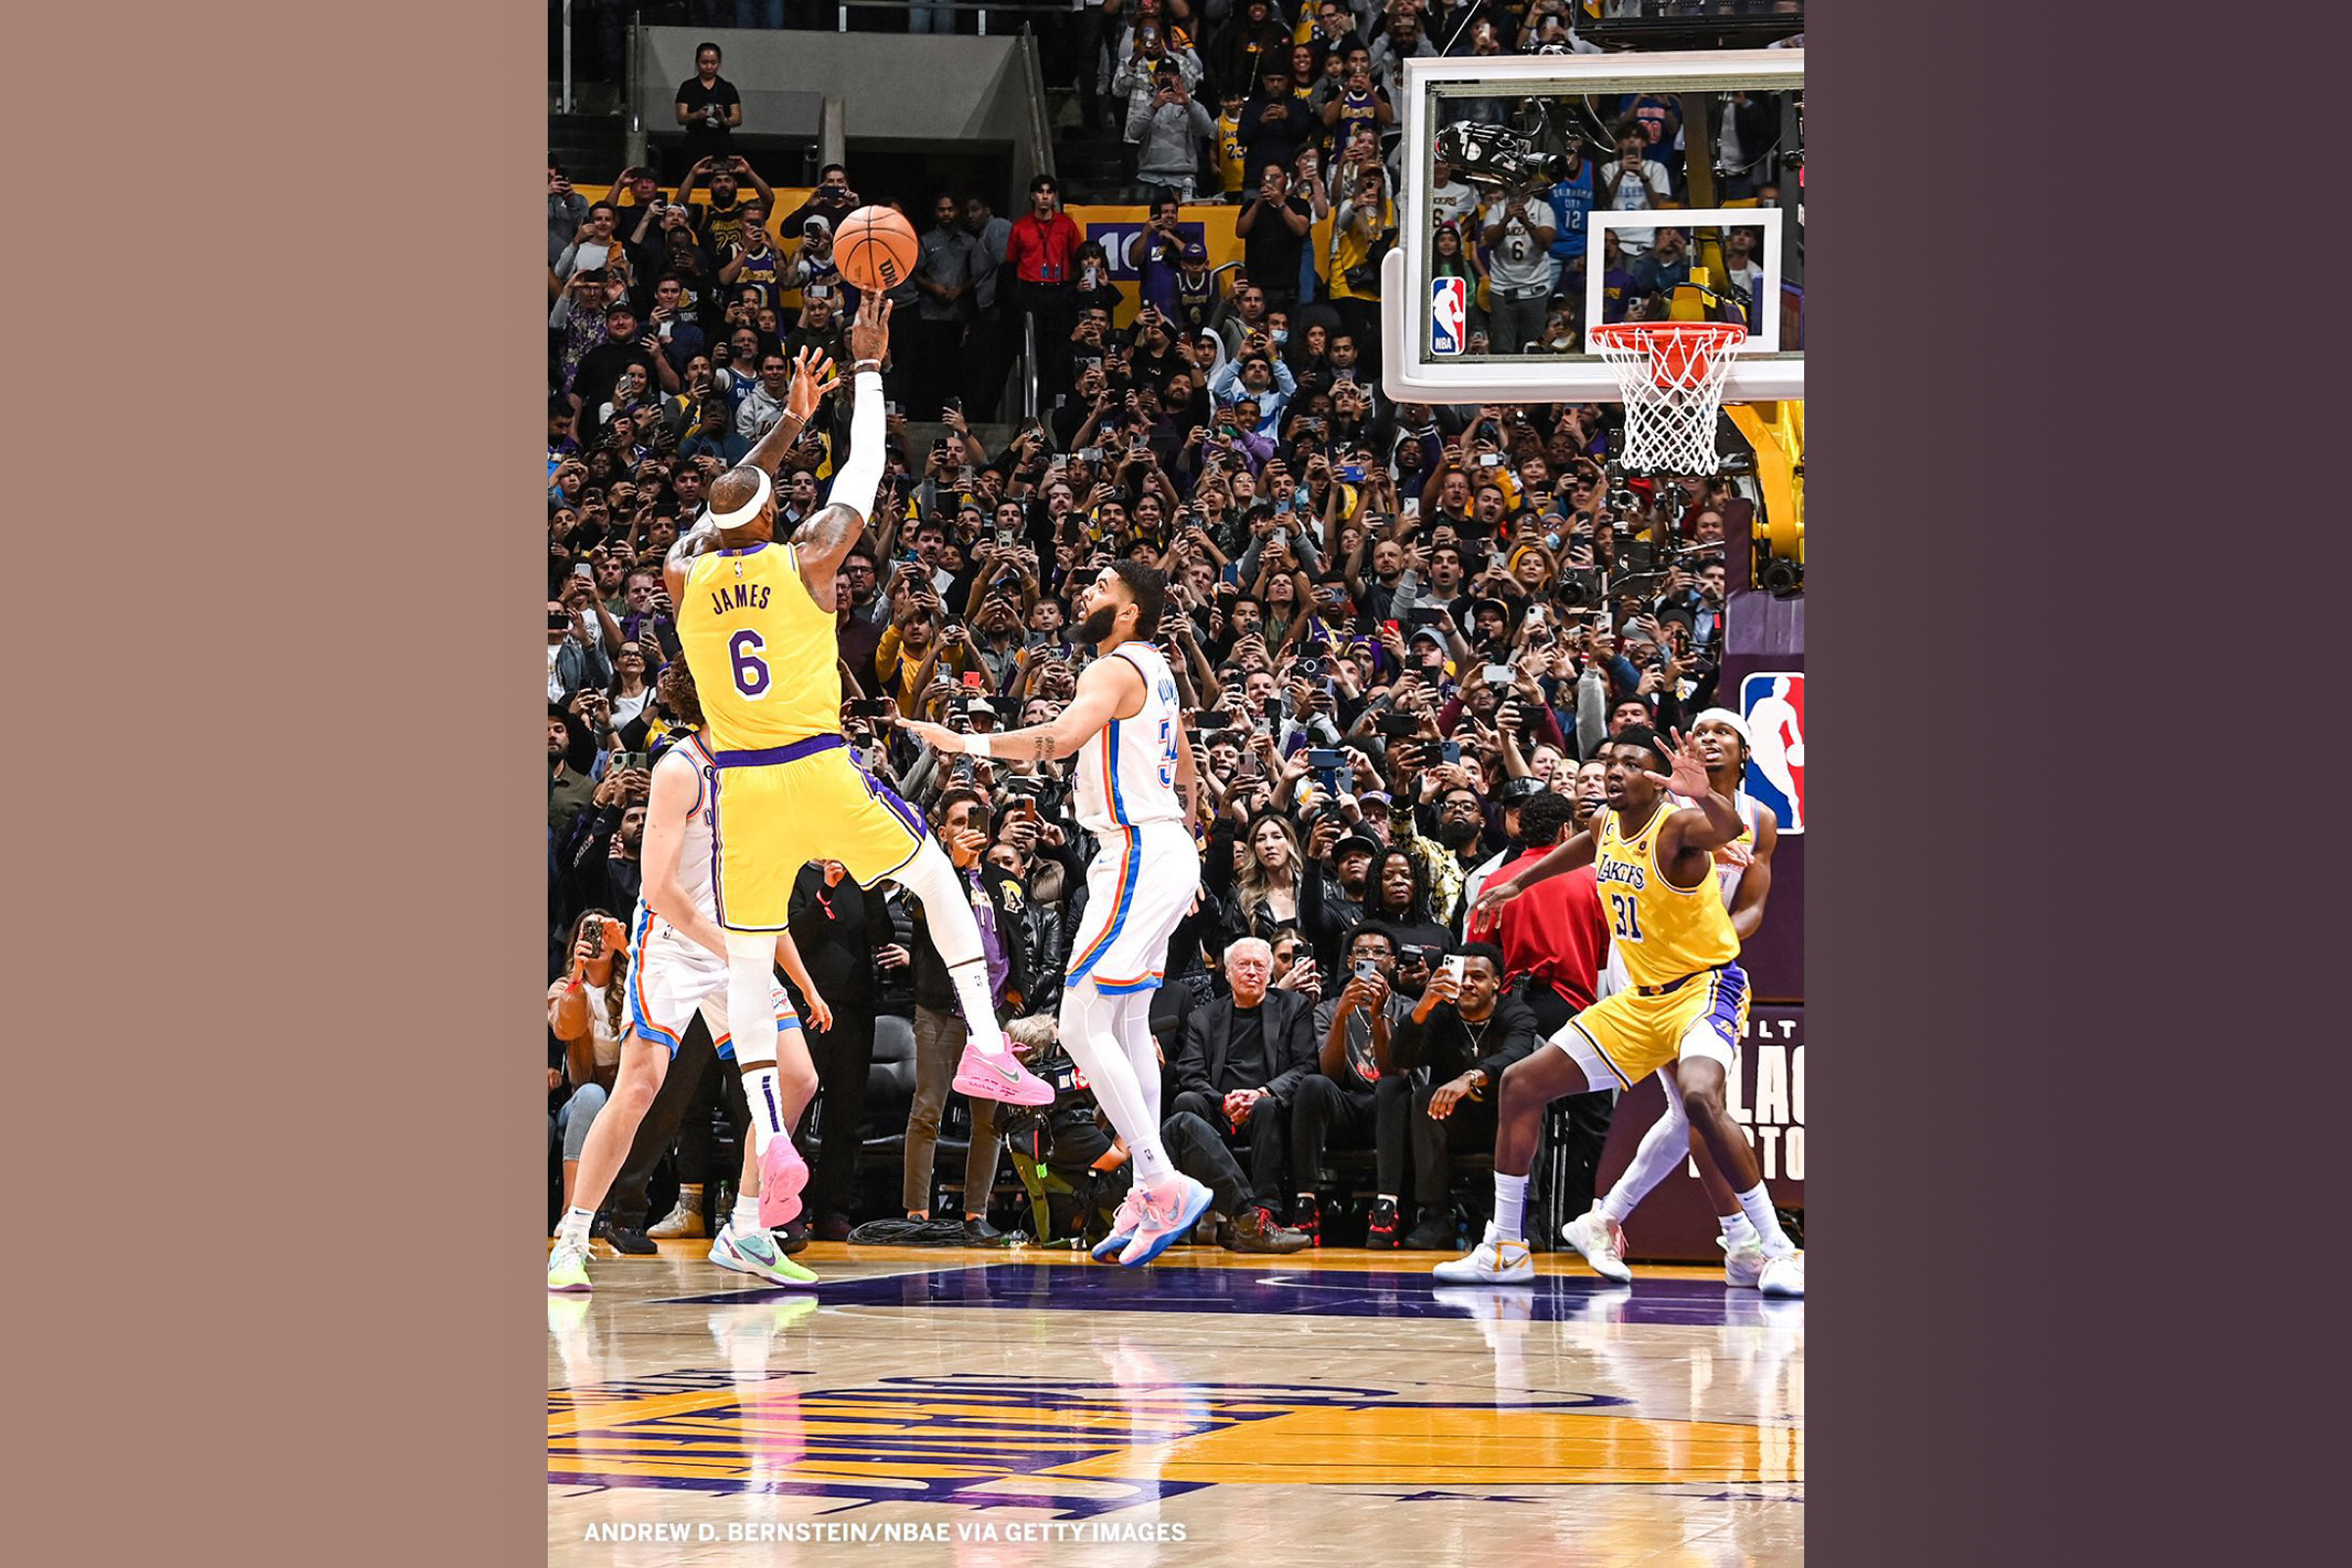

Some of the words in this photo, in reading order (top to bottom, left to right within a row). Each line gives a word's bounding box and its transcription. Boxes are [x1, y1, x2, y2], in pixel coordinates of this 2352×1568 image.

[1433, 208, 1444, 228] 6
[1564, 210, 1581, 229] 12
[1512, 240, 1524, 261] 6
[1435, 337, 1452, 350] NBA
[711, 584, 771, 615] JAMES
[728, 628, 772, 698] 6
[1611, 894, 1642, 941] 31
